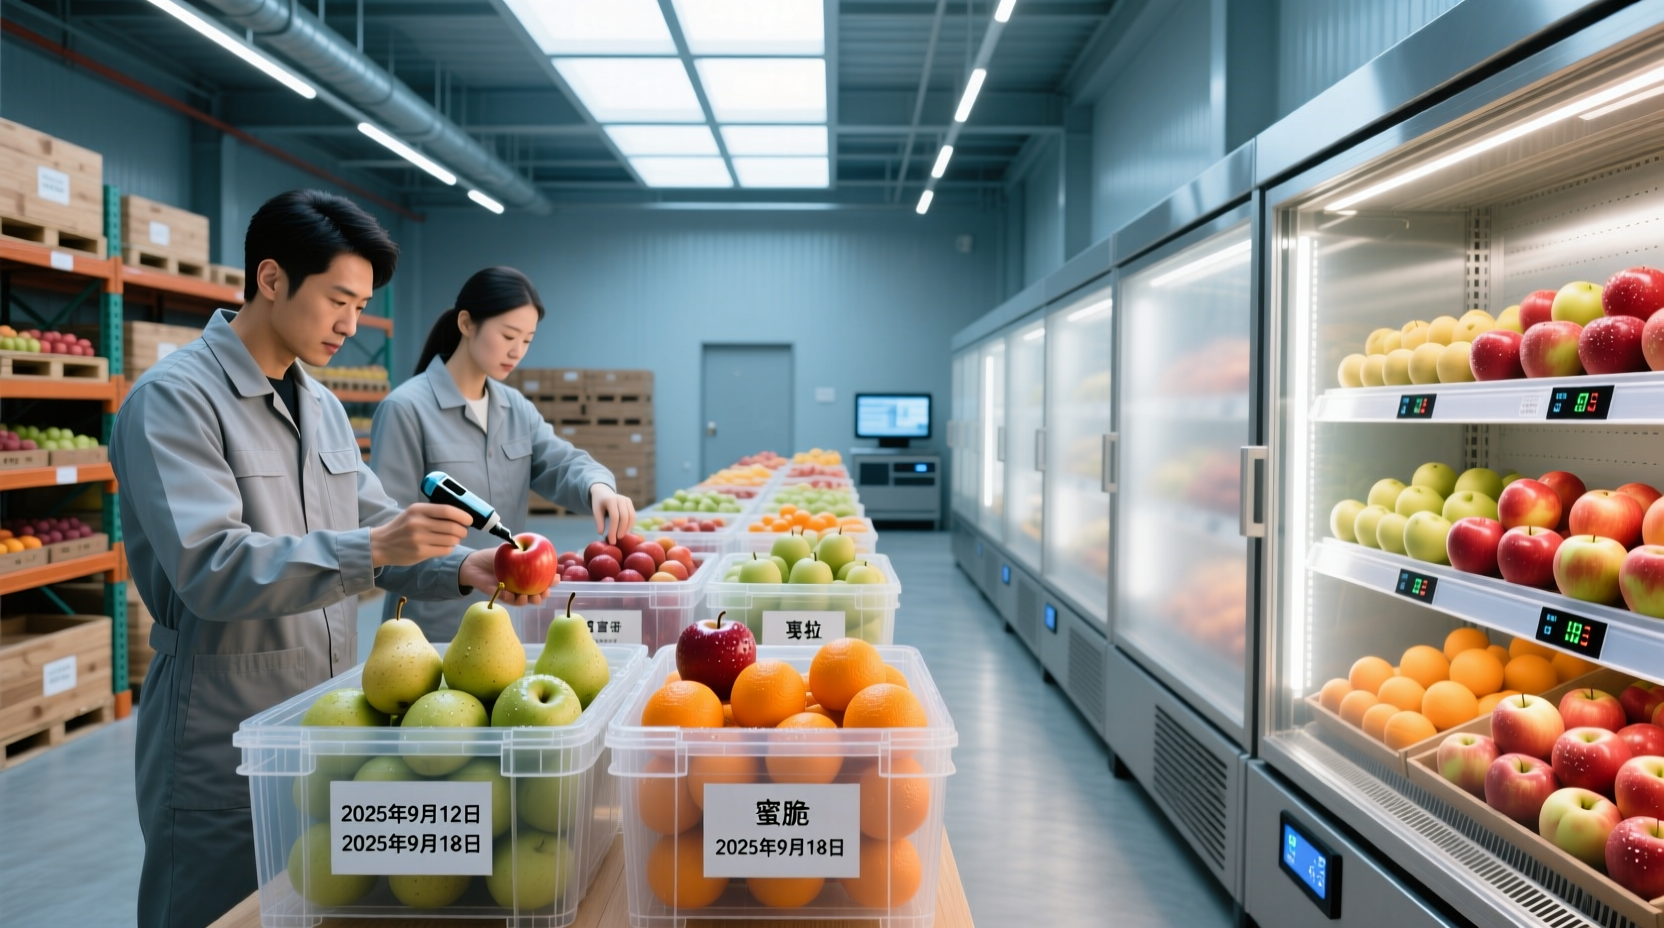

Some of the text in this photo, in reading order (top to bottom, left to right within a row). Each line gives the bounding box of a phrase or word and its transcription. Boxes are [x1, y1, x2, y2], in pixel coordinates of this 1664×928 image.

[340, 803, 481, 825] 2025年9月12日
[755, 798, 811, 828] 蜜脆
[341, 833, 481, 855] 2025年9月18日
[715, 837, 845, 858] 2025年9月18日
